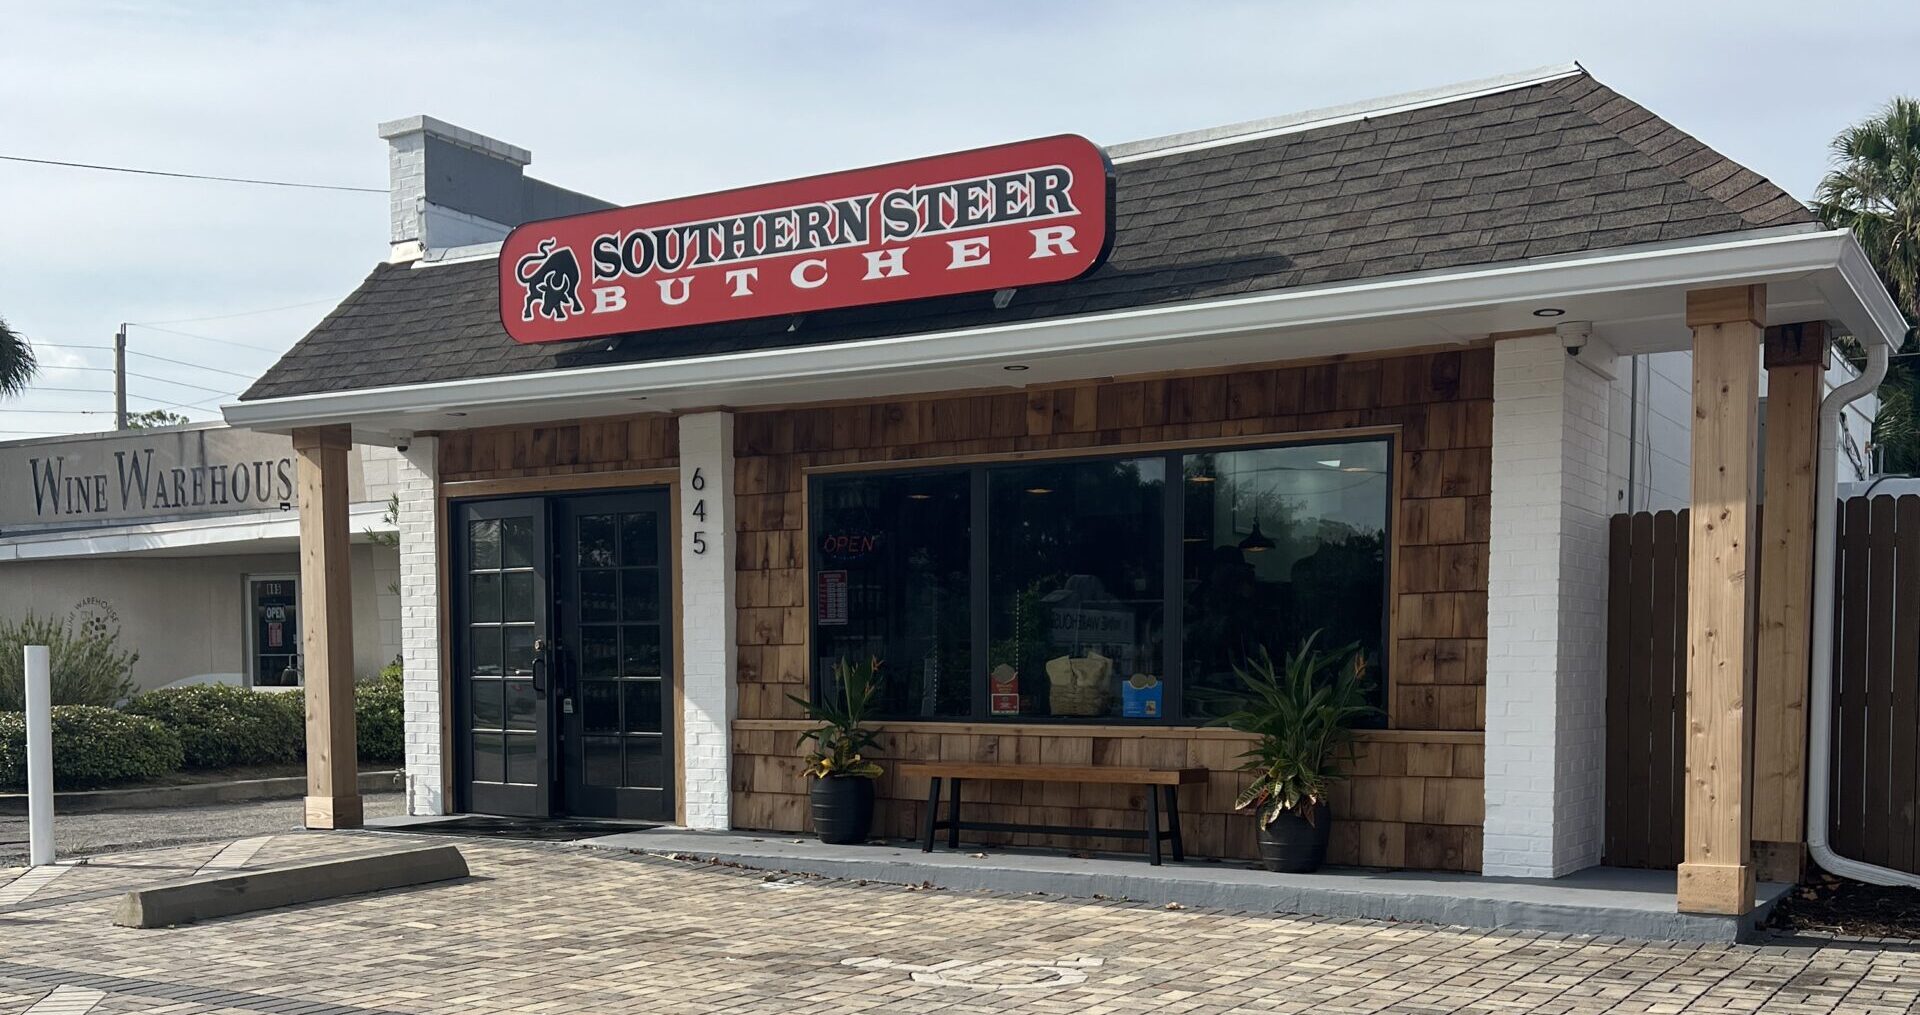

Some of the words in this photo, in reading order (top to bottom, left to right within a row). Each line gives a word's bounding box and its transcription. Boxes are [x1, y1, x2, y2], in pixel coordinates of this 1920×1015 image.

[592, 193, 880, 281] SOUTHERN
[881, 164, 1083, 245] STEER
[592, 225, 1078, 314] BUTCHER
[29, 455, 109, 516] WINE
[114, 449, 298, 509] WAREHOUS
[691, 466, 707, 555] 645
[823, 534, 876, 553] OPEN
[266, 606, 286, 619] OPEN
